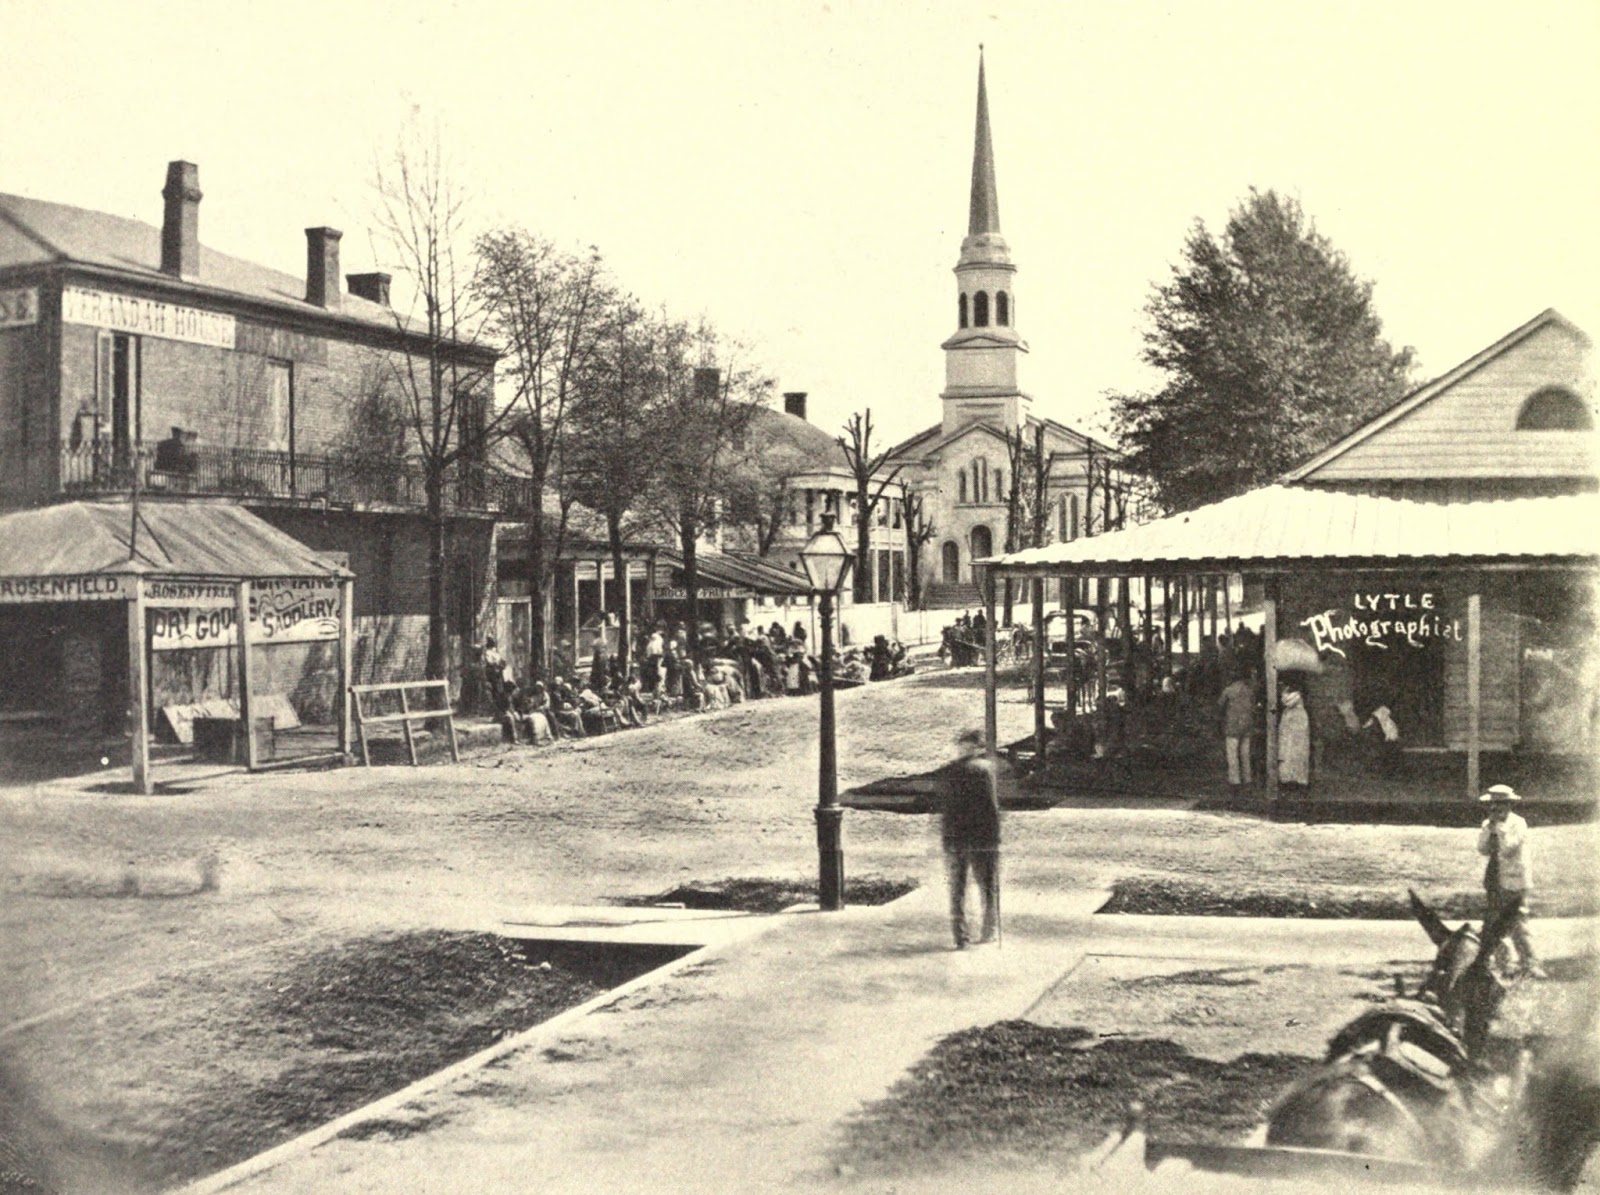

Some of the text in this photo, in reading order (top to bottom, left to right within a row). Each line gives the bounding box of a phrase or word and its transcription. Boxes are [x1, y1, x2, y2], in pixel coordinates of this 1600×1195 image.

[174, 306, 233, 345] HOUSE
[262, 598, 336, 638] SADDLERY
[1355, 593, 1434, 611] LYTLE
[154, 606, 190, 638] DRY
[1300, 609, 1463, 658] Photographist
